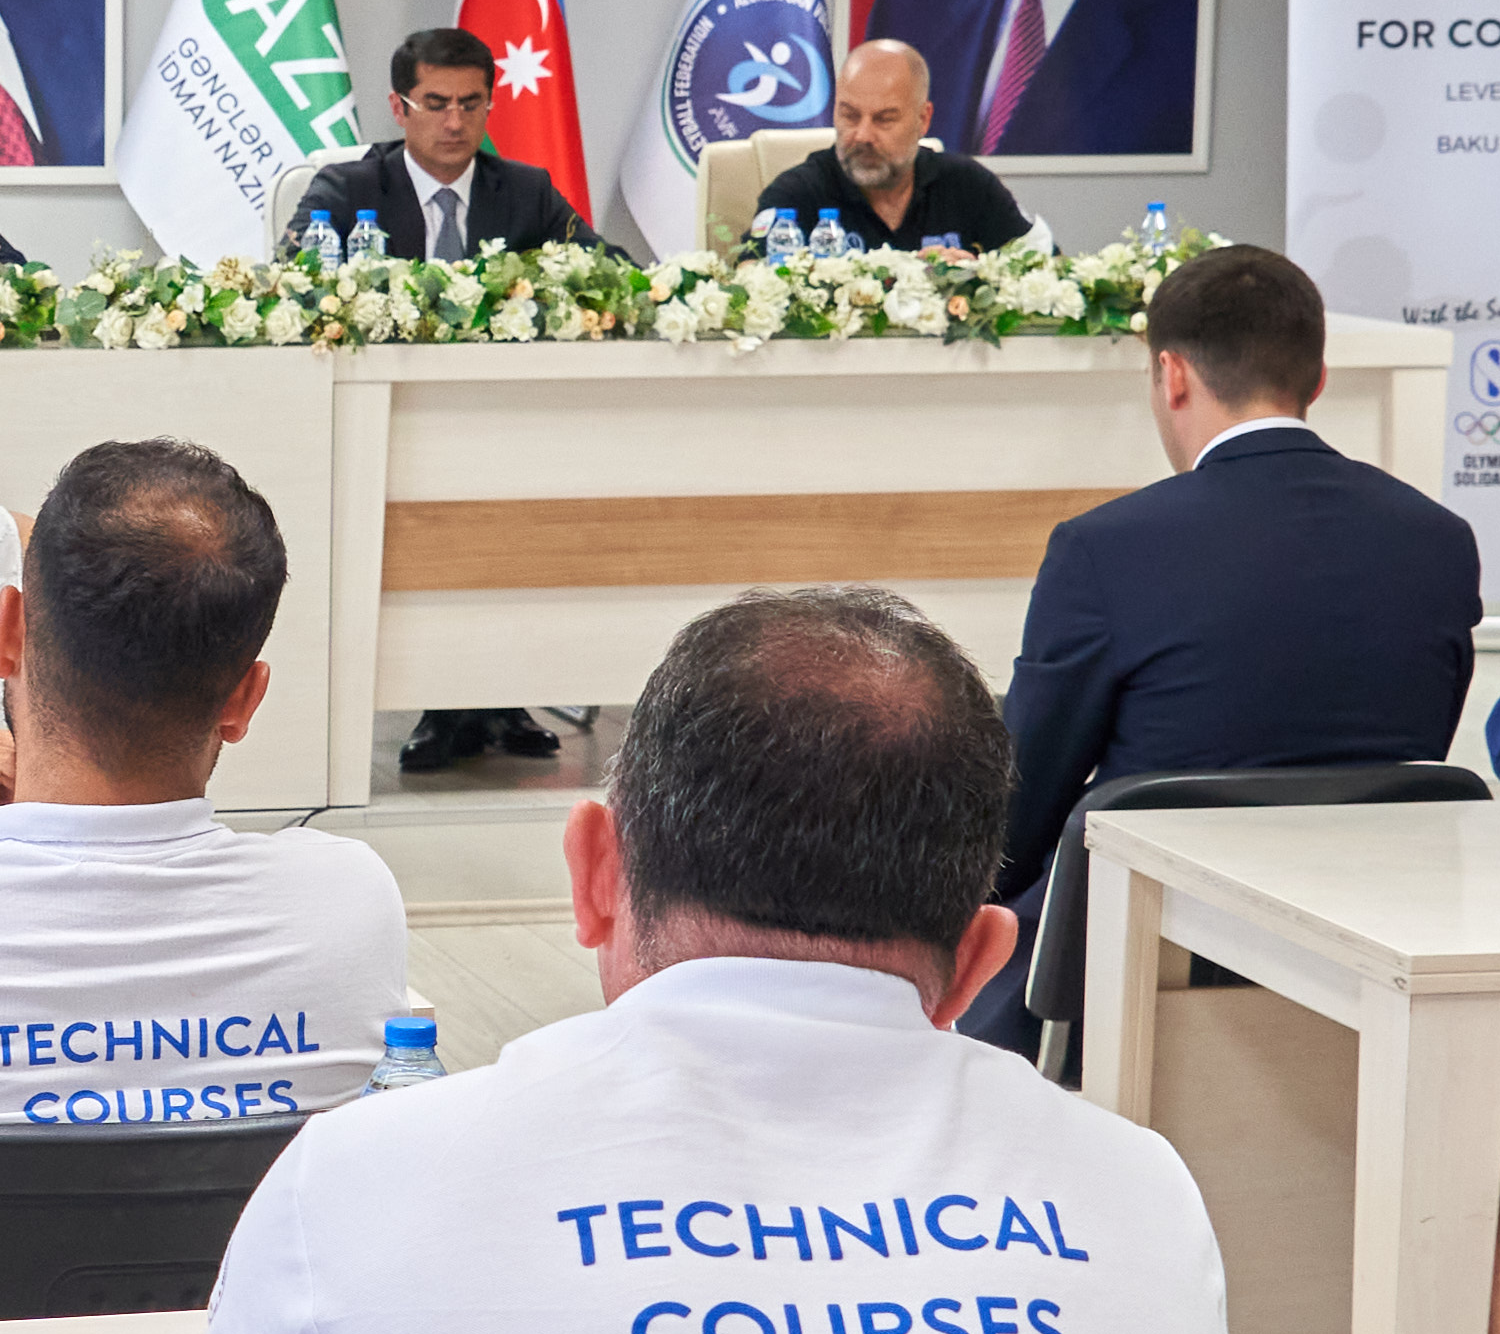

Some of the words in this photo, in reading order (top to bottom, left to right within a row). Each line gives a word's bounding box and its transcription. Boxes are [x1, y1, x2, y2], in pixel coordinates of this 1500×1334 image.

[1357, 20, 1435, 49] FOR
[158, 49, 223, 141] İDMAN
[179, 37, 273, 164] GƏNCLƏR
[1437, 134, 1500, 153] BAKU
[1403, 302, 1448, 324] With
[1455, 300, 1480, 323] the
[557, 1193, 1089, 1266] TECHNICAL
